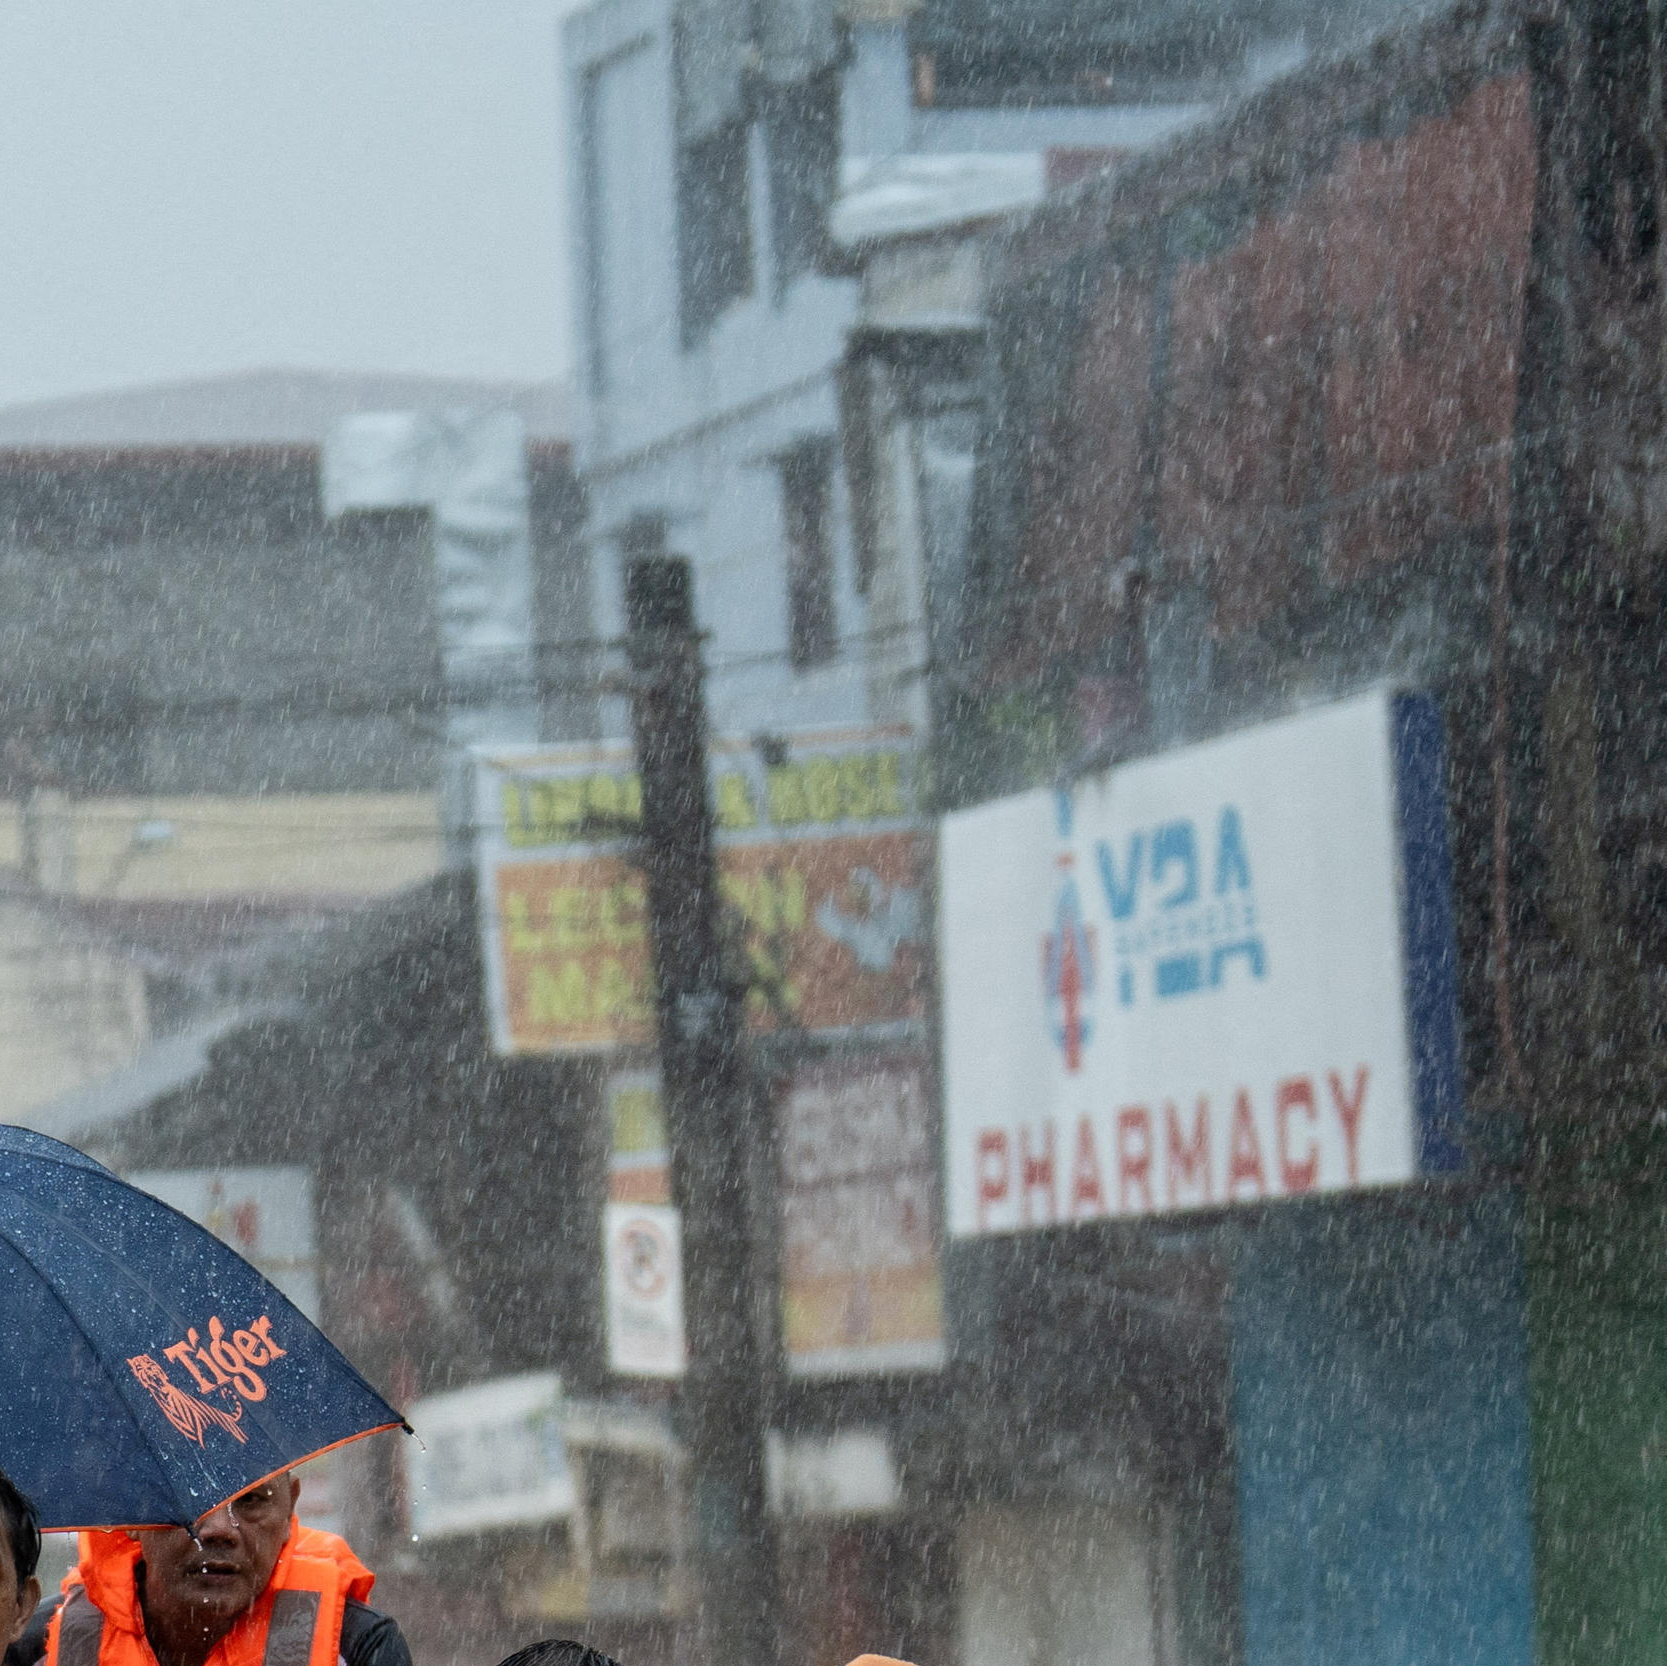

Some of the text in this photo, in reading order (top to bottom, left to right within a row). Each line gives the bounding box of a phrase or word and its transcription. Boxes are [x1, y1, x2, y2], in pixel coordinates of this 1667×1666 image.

[505, 867, 806, 954] LECN
[975, 1063, 1371, 1232] PHARMACY
[163, 1314, 288, 1402] Tiger
